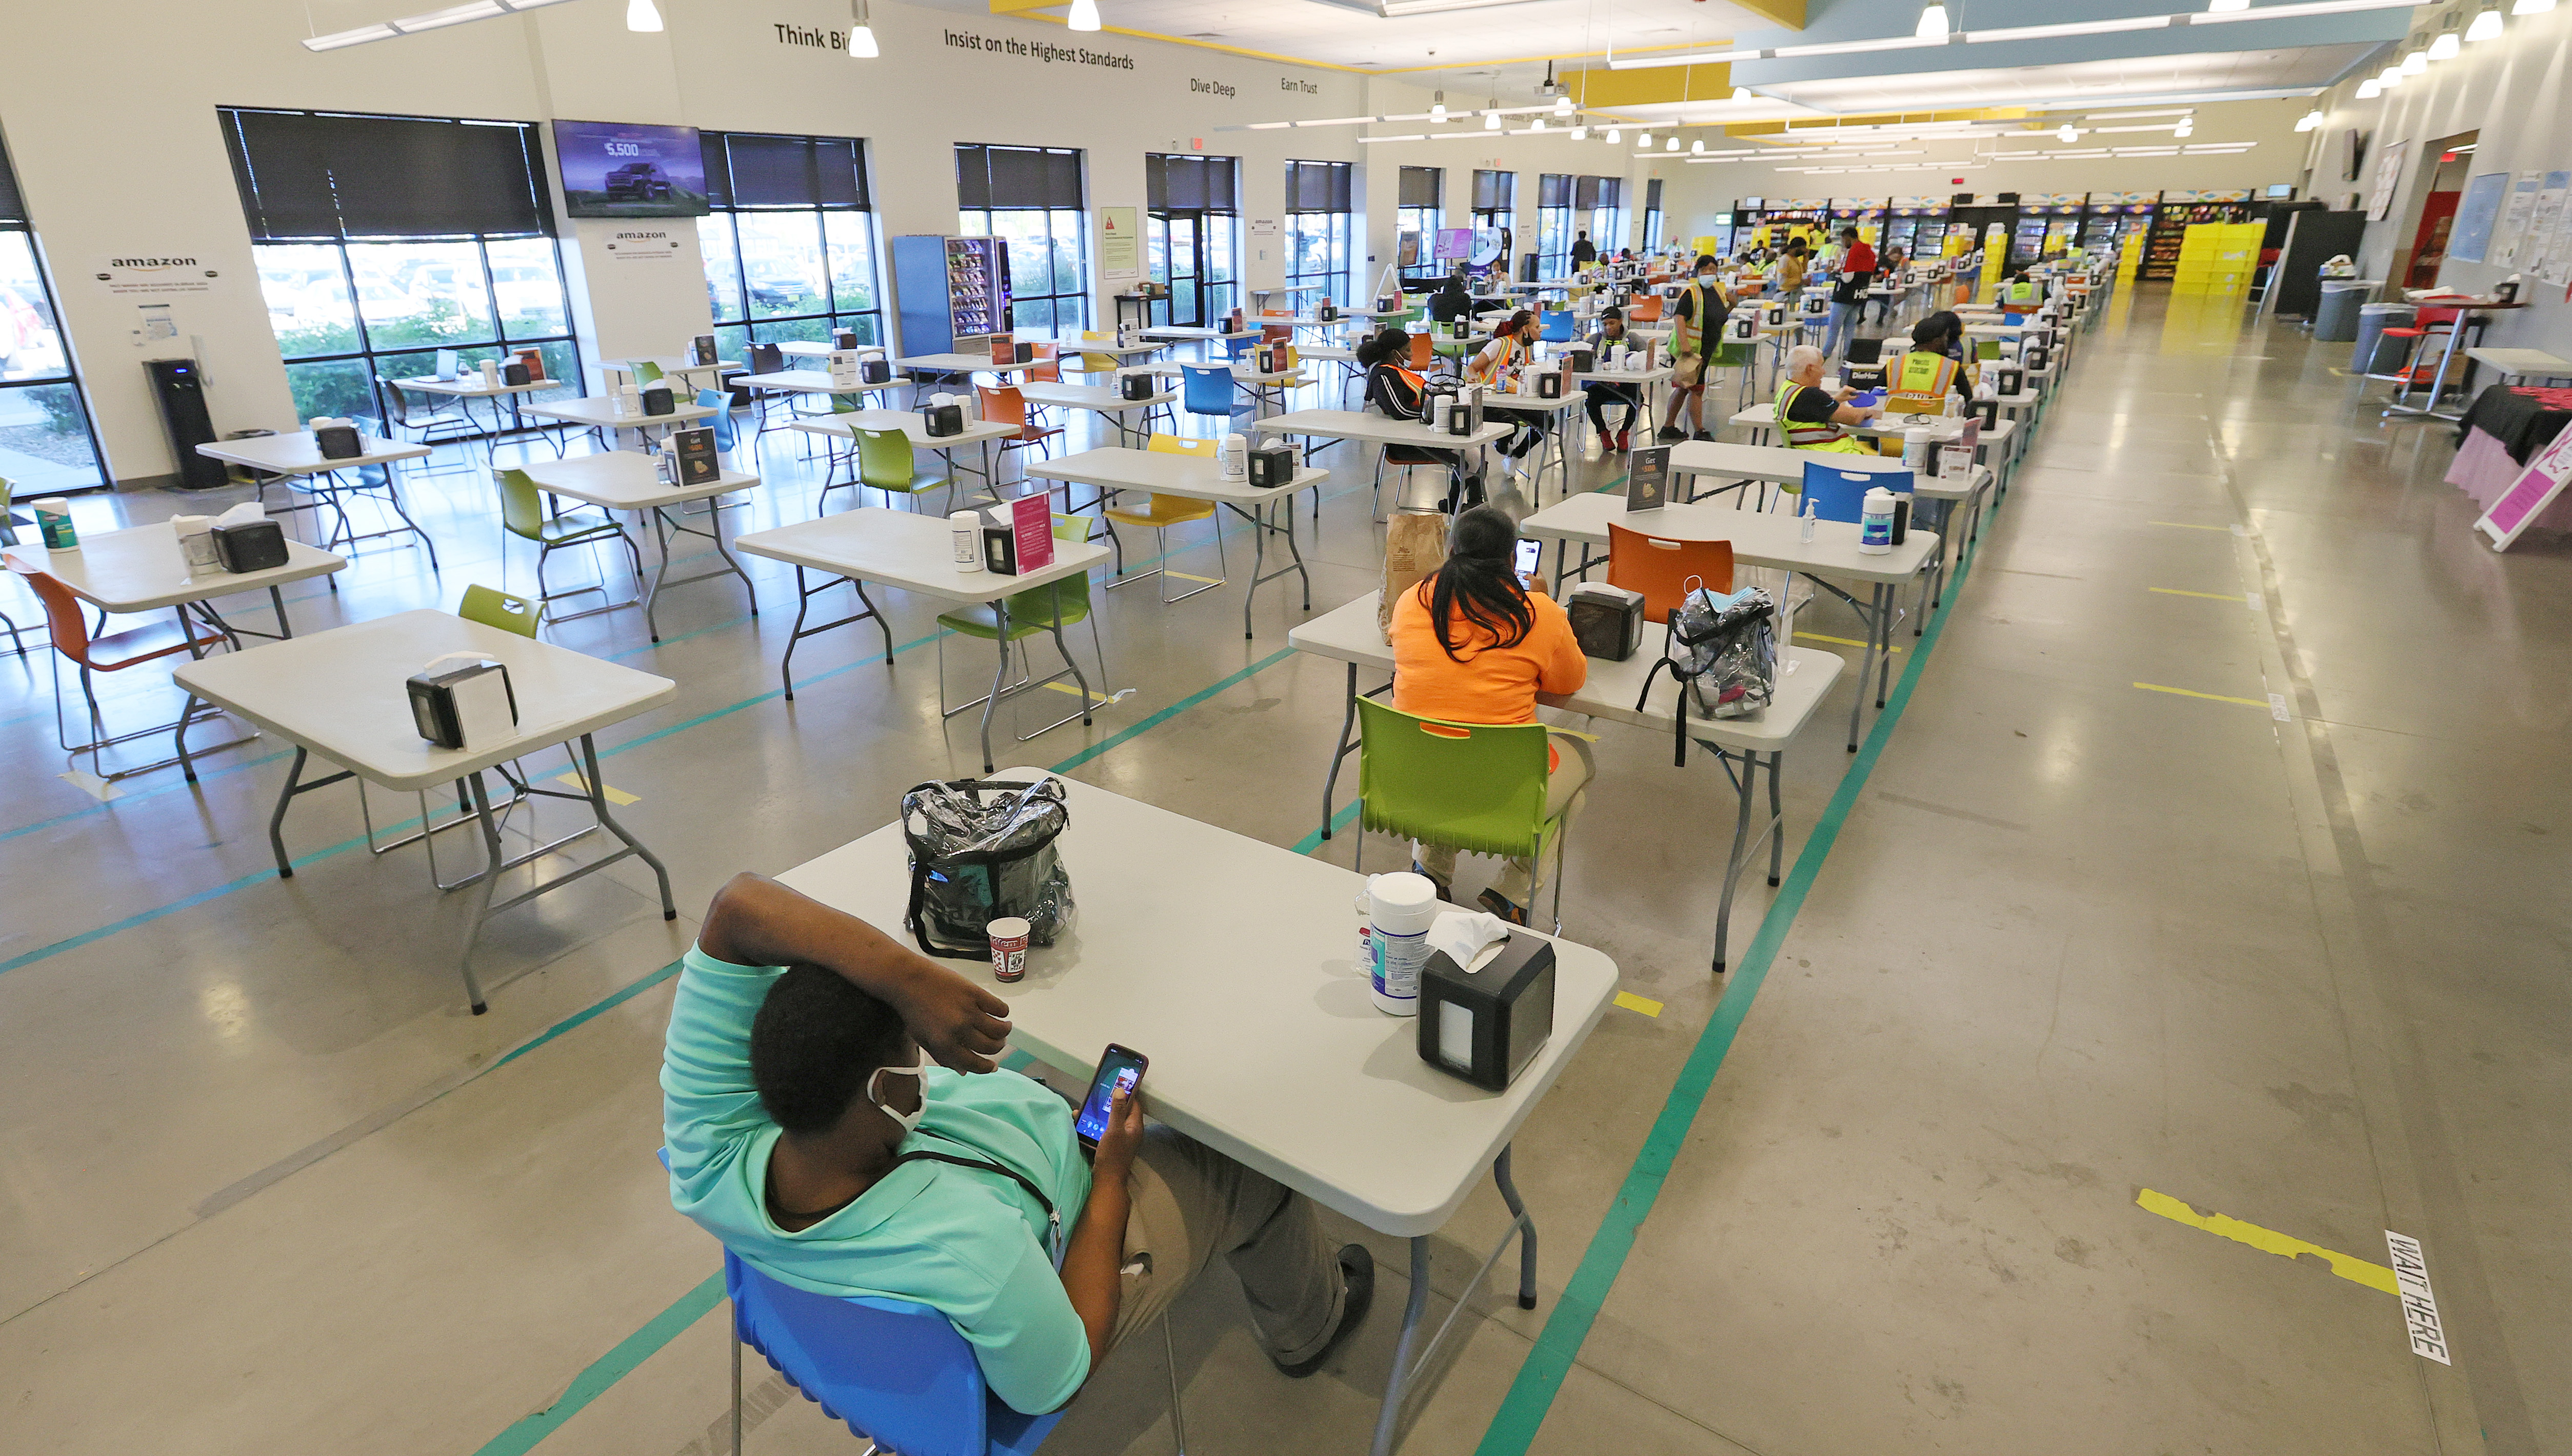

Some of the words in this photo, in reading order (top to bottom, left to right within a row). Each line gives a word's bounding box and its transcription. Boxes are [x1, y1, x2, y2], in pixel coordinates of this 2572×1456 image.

[774, 24, 825, 48] Think
[830, 31, 850, 54] Bi
[944, 29, 981, 50] Insist
[986, 37, 1002, 52] on
[1006, 37, 1027, 56] the
[1031, 41, 1076, 63] Highest
[1079, 48, 1134, 70] Standards
[1191, 78, 1210, 93] Dive
[1213, 81, 1235, 99] Deep
[1282, 78, 1298, 91] Earn
[1300, 80, 1318, 94] Trust
[111, 257, 197, 267] amazon
[2390, 1239, 2428, 1292] WAIT
[2403, 1291, 2446, 1358] HERE
